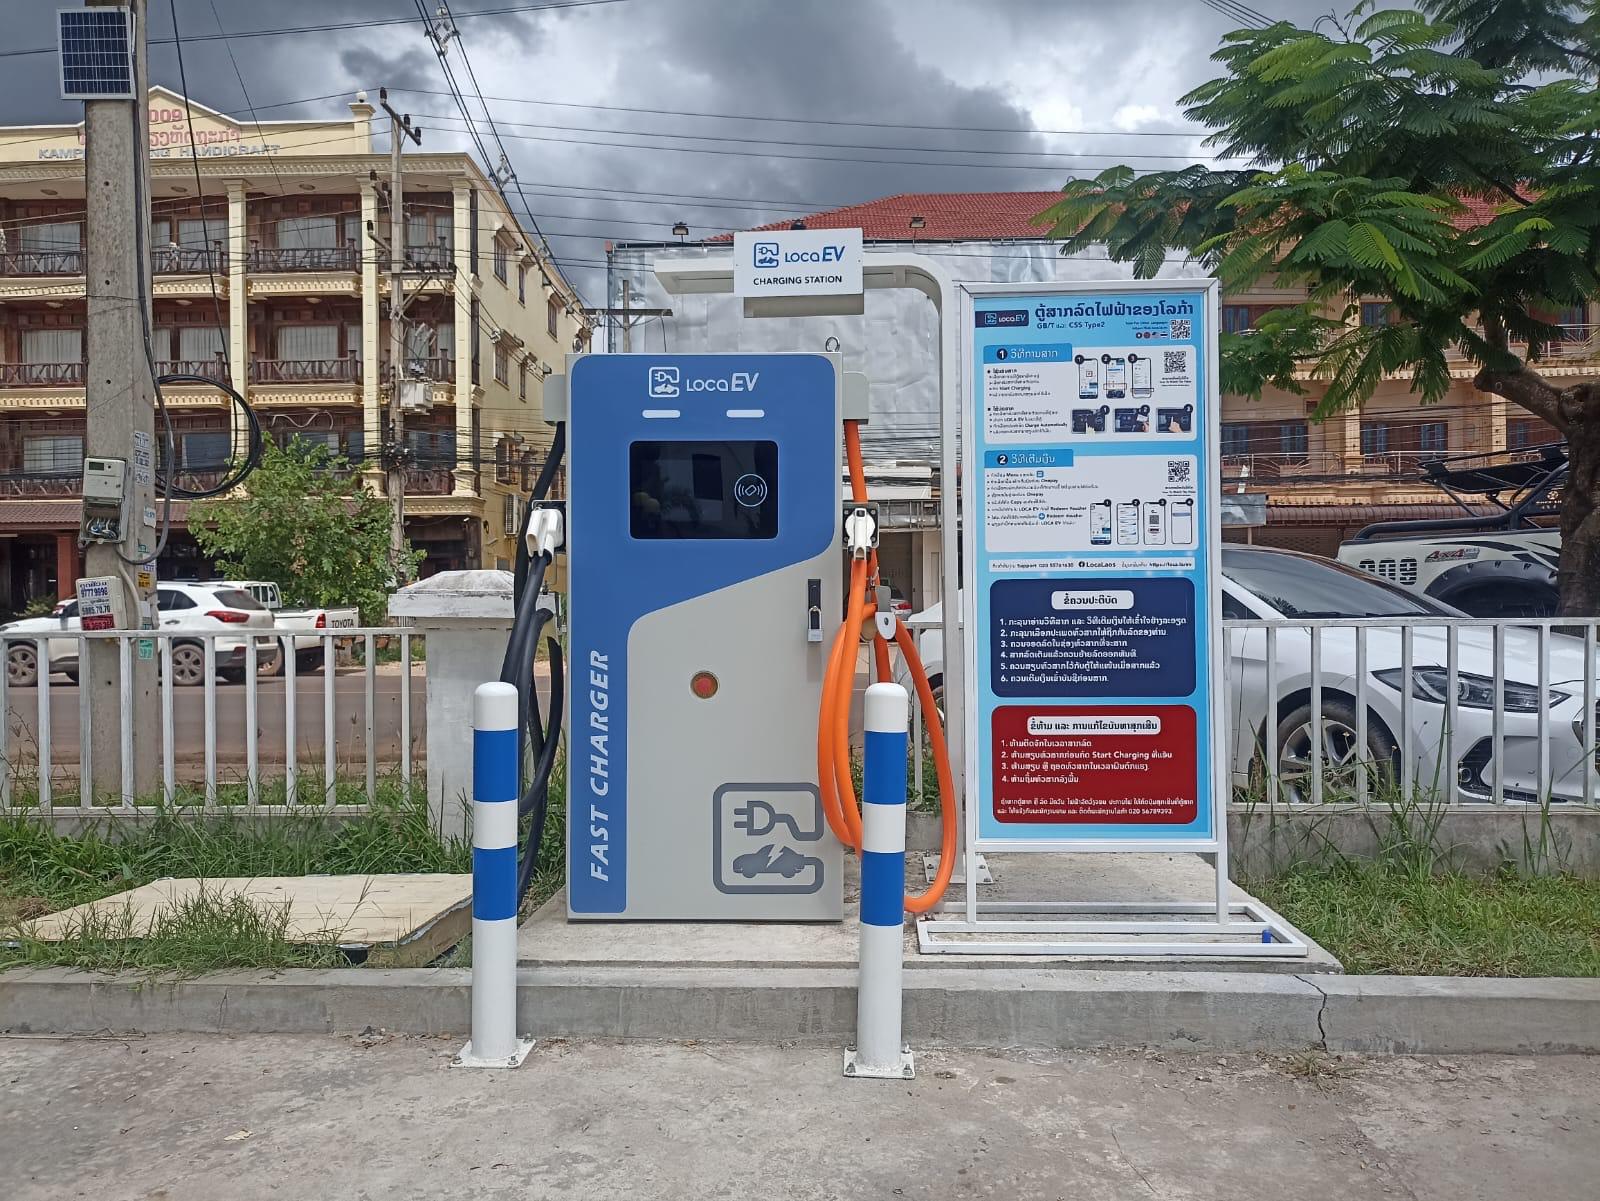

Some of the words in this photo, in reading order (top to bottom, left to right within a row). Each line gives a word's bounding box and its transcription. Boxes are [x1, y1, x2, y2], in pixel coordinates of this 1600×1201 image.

[753, 276, 802, 286] CHARGING
[804, 275, 842, 284] STATION
[1036, 322, 1055, 330] GB/T
[1068, 321, 1083, 329] CSS
[1084, 321, 1106, 330] Type2
[331, 618, 354, 628] TOYOTA
[589, 650, 609, 797] CHARGER
[1092, 751, 1112, 759] Start
[1113, 751, 1150, 761] Charging
[590, 804, 609, 882] FAST
